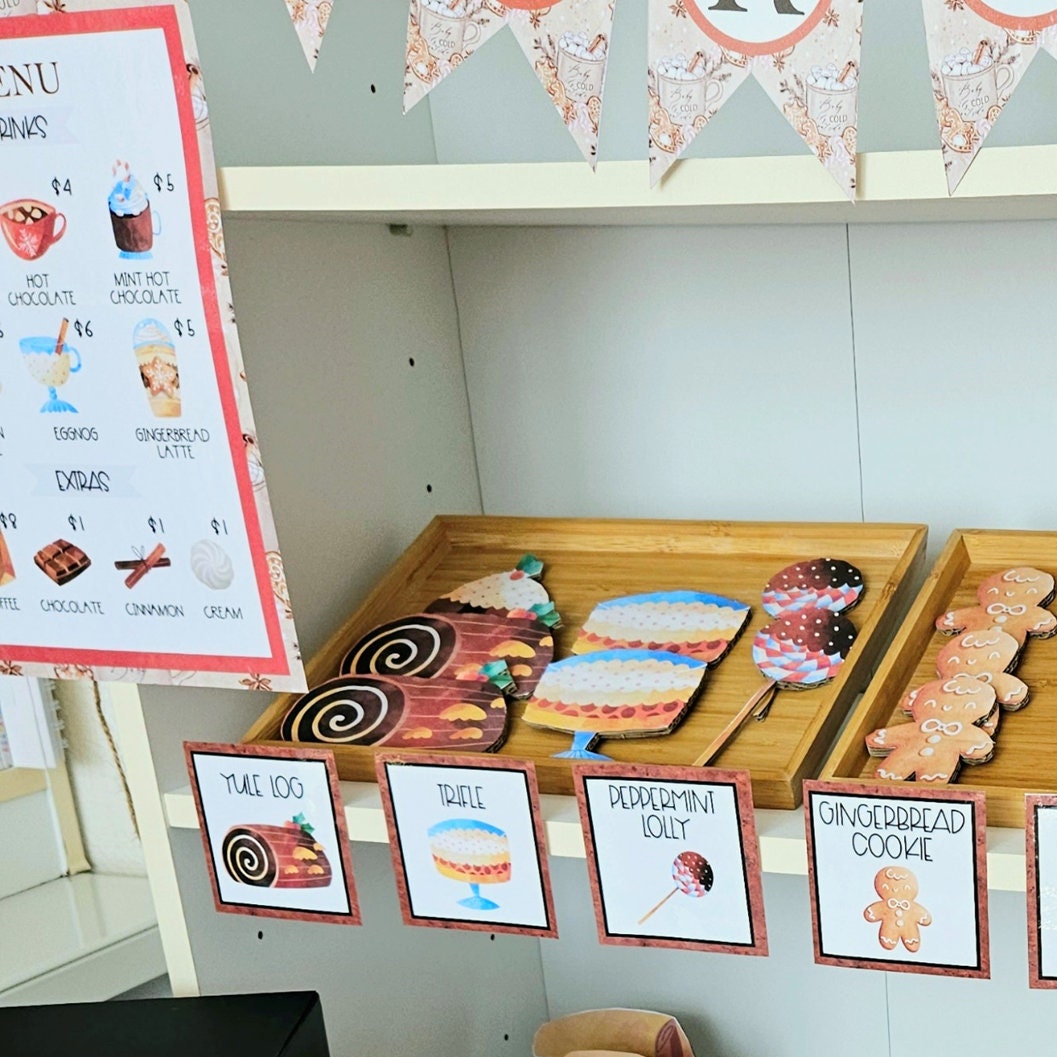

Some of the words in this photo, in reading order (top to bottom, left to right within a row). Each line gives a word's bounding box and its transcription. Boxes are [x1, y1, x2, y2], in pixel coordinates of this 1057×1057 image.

[0, 62, 60, 97] ENU
[0, 115, 48, 140] RINKS
[51, 177, 72, 196] $4
[154, 172, 175, 192] $5
[26, 274, 50, 288] HOT
[114, 273, 142, 287] MINT
[147, 271, 170, 286] HOT
[8, 290, 77, 306] CHOCOLATE
[110, 288, 182, 305] CHOCOLATE
[74, 318, 93, 338] $6
[174, 317, 195, 337] $5
[54, 426, 99, 442] EGGNOG
[135, 427, 210, 443] GINGERBREAD
[157, 444, 195, 460] LATTE
[55, 470, 110, 492] EXTRAS
[68, 513, 85, 531] $1
[148, 515, 165, 534] $1
[211, 517, 228, 535] $1
[40, 599, 105, 615] CHOCOLATE
[125, 603, 185, 618] CINNAMON
[203, 605, 244, 620] CREAM
[220, 772, 263, 797] YULE
[270, 774, 304, 799] LOG
[436, 783, 487, 810] TRIFLE
[608, 784, 716, 815] PEPPERMINT
[641, 814, 690, 840] LOLLY
[818, 801, 965, 834] GINGERBREAD
[851, 832, 934, 862] COOKIE
